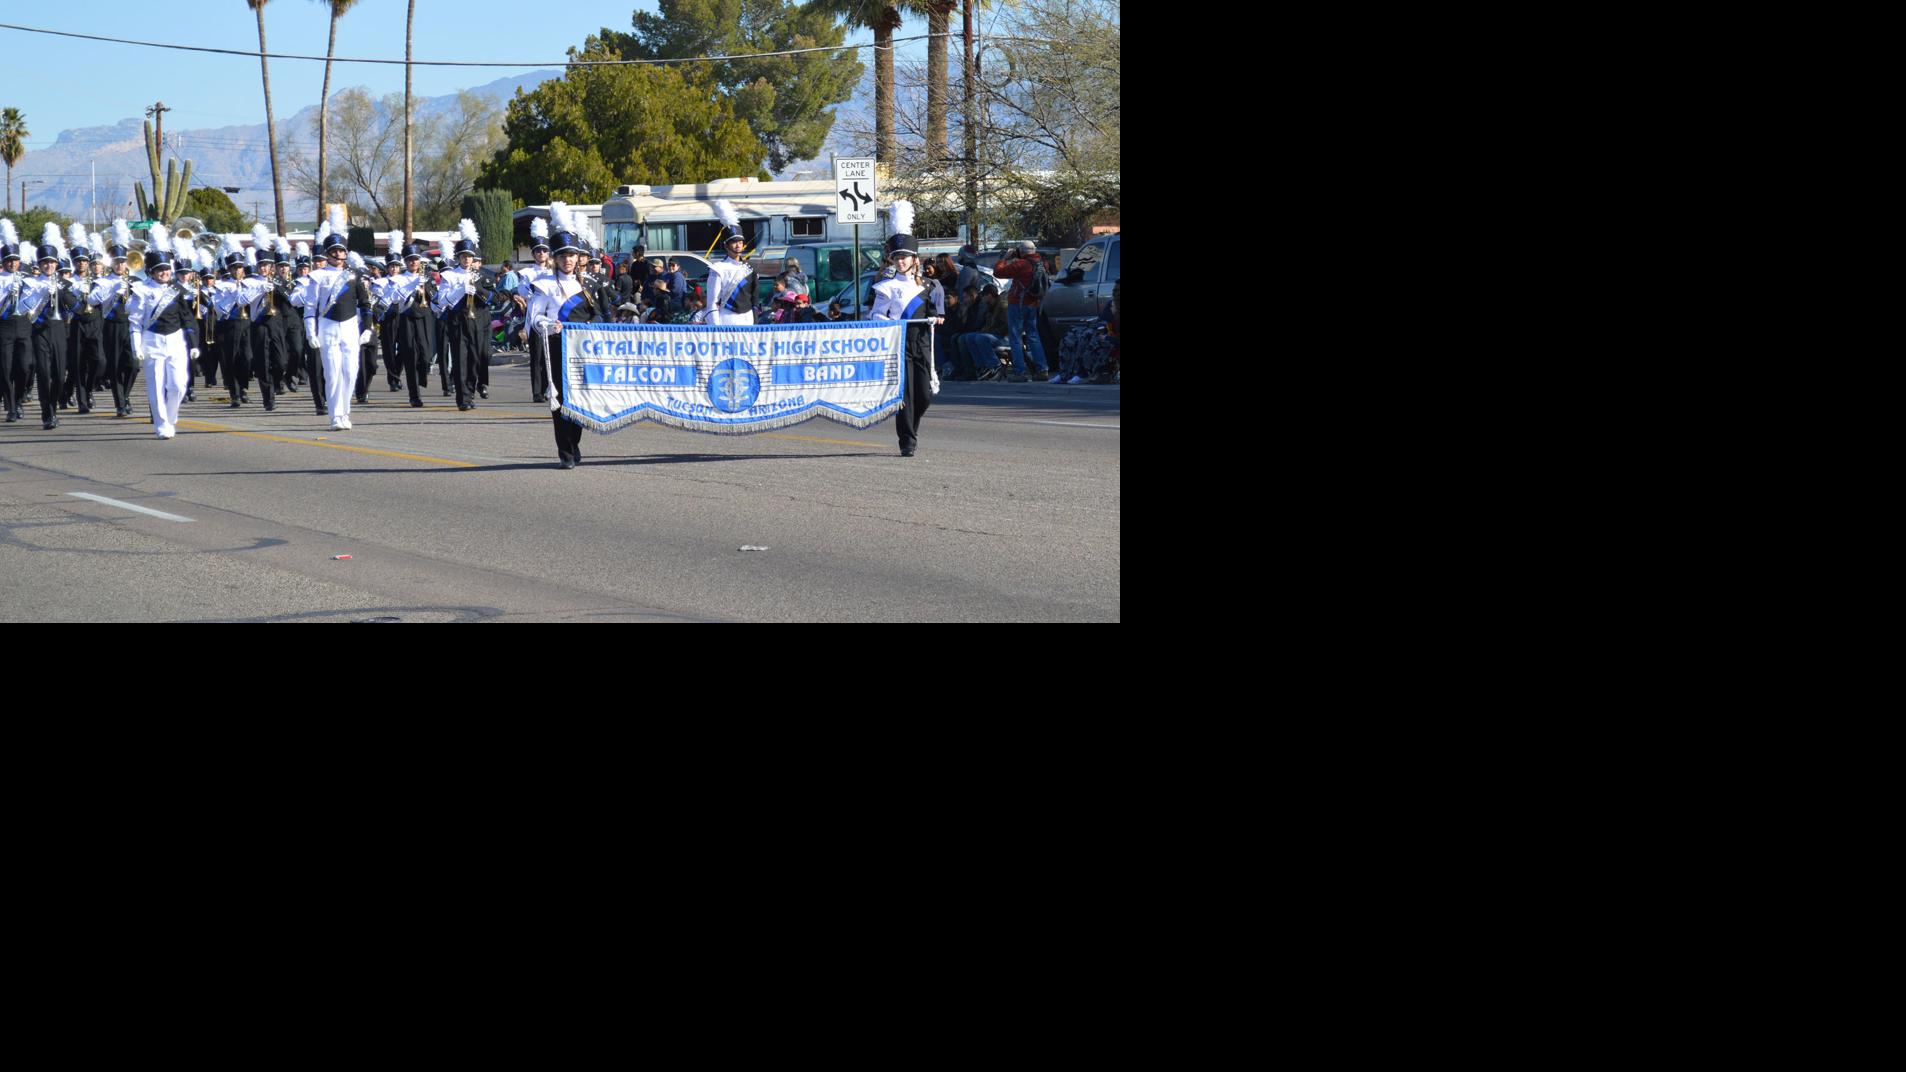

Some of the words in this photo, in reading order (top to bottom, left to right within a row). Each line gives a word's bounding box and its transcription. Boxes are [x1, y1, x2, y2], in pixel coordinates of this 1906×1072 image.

[582, 339, 668, 356] CATALINA
[674, 341, 767, 357] FOOTHILLS
[774, 340, 816, 356] HIGH
[821, 337, 889, 355] SCHOOL
[603, 366, 676, 383] FALCON
[804, 365, 856, 381] BAND
[748, 395, 805, 416] ARIZONA
